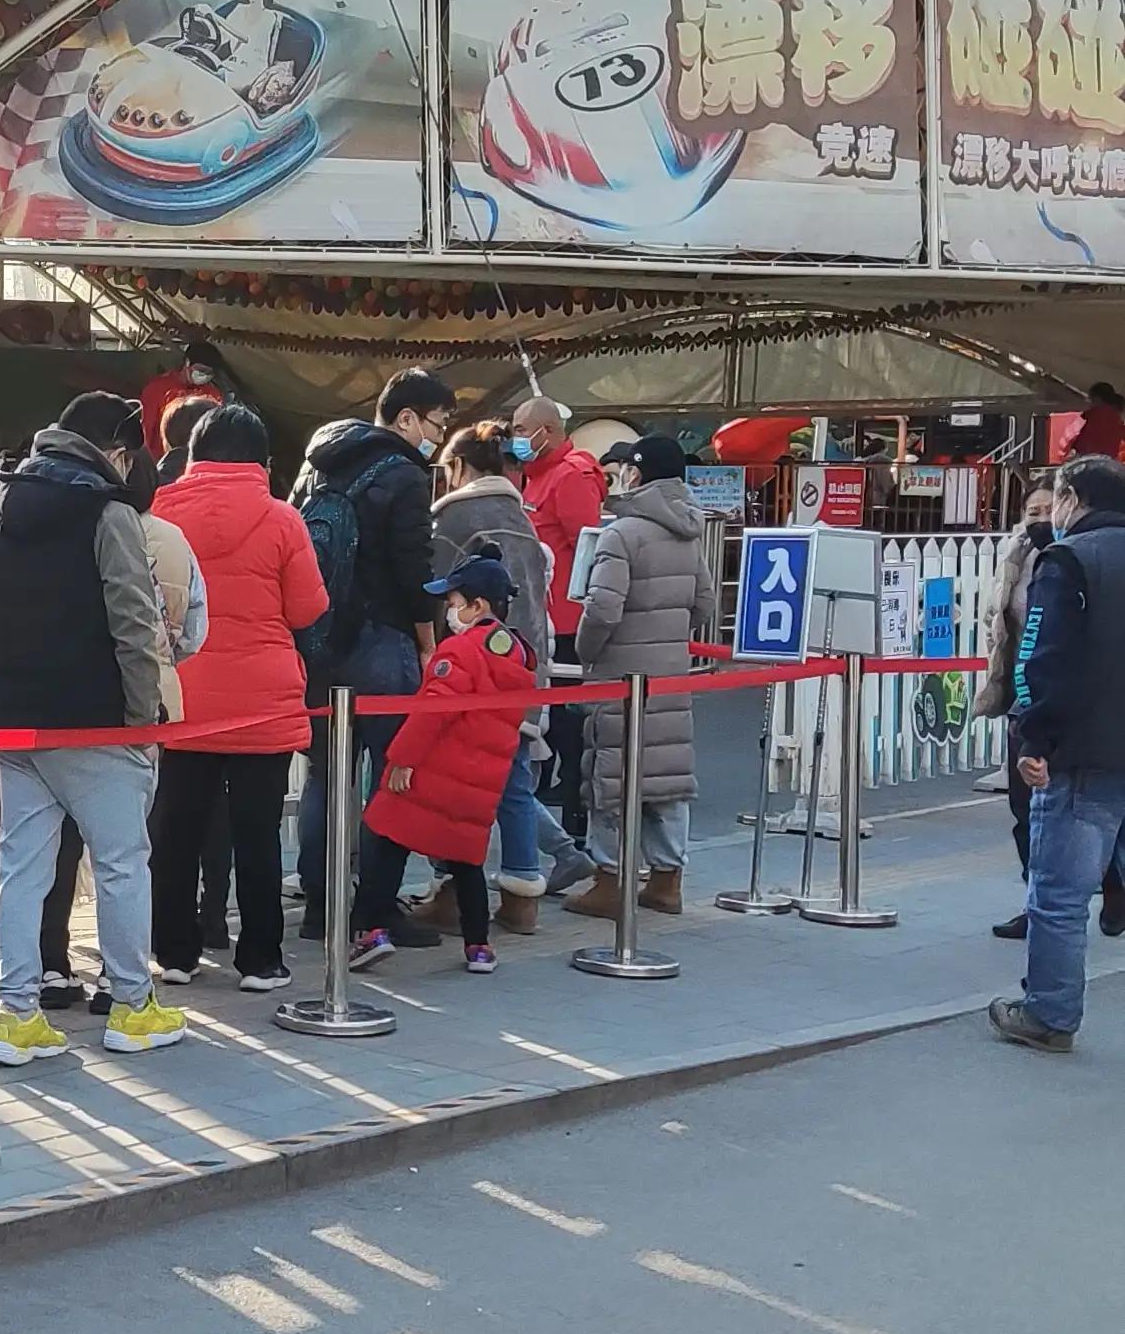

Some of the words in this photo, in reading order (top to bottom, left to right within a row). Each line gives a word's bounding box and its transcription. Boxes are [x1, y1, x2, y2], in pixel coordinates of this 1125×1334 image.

[569, 53, 646, 101] 73
[816, 121, 897, 177] 竞速
[758, 547, 797, 643] 入口
